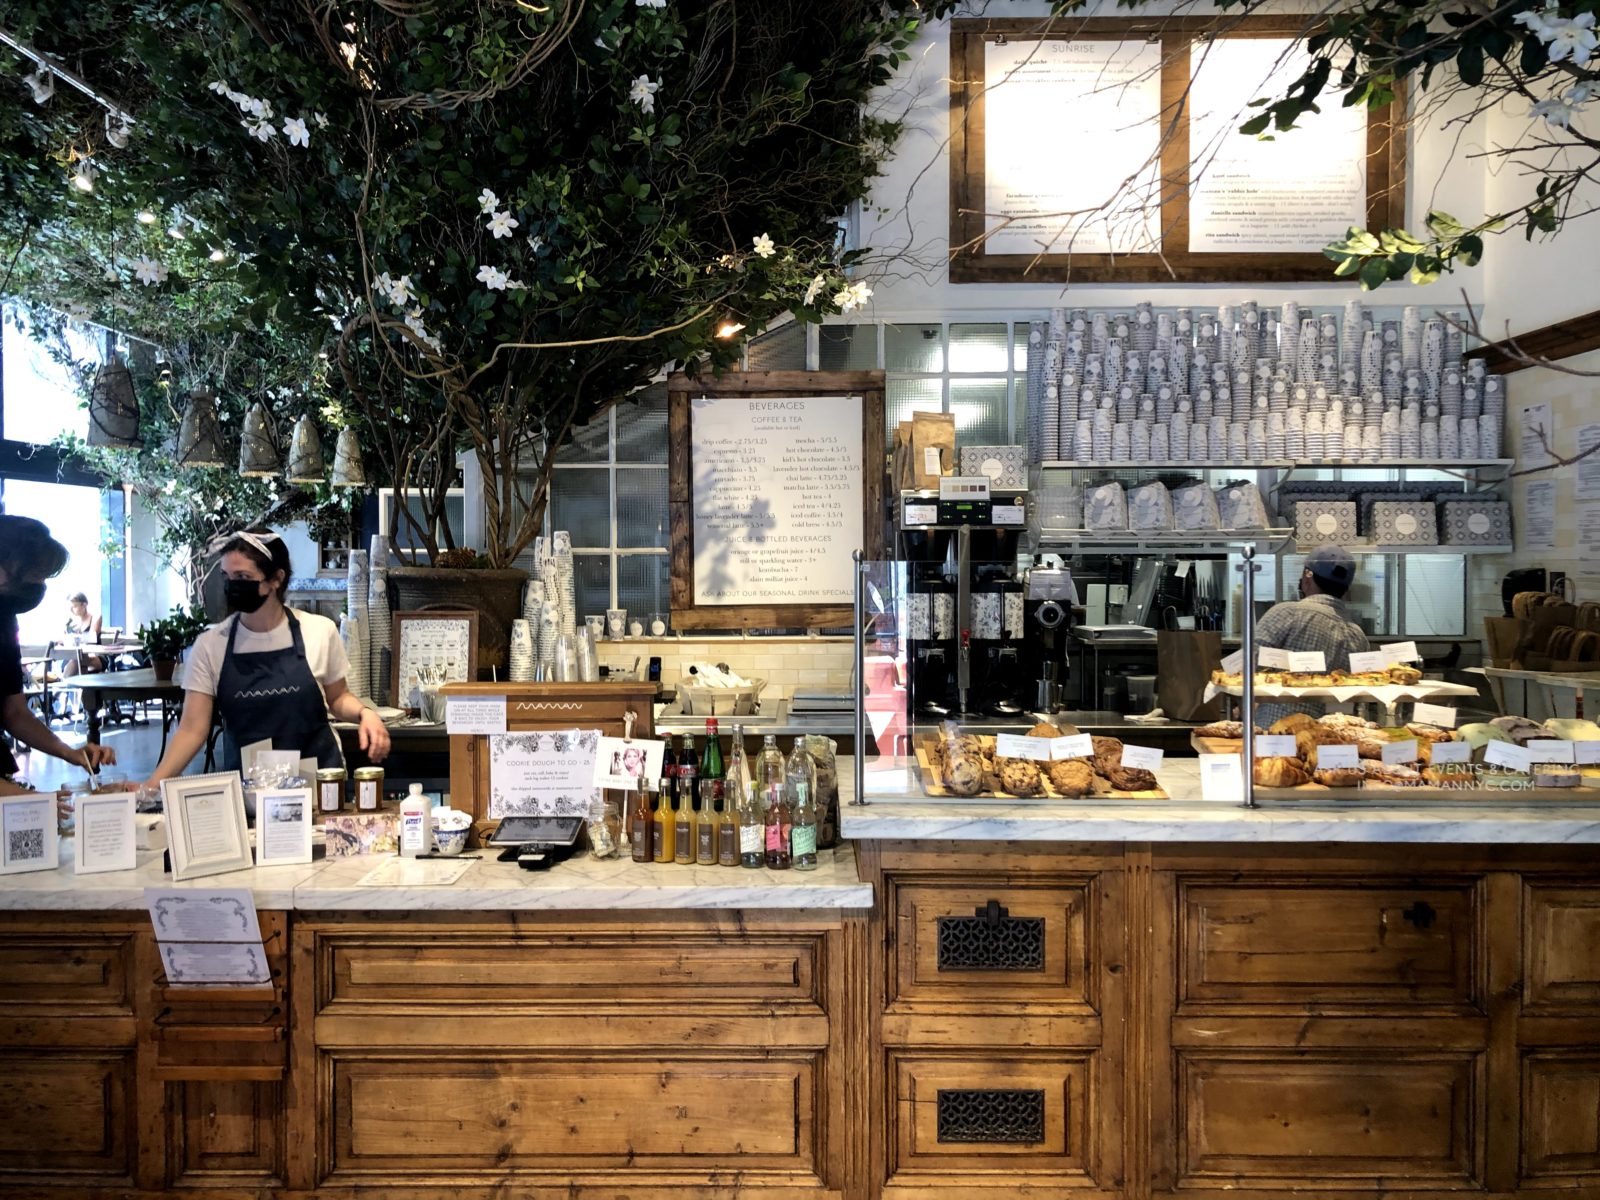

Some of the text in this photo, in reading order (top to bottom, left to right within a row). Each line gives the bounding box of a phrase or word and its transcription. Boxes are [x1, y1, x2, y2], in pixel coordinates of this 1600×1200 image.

[1051, 44, 1095, 54] SUNRISE
[749, 402, 805, 410] BEVERAGES
[1428, 764, 1484, 775] EVENTS
[1490, 764, 1498, 775] &
